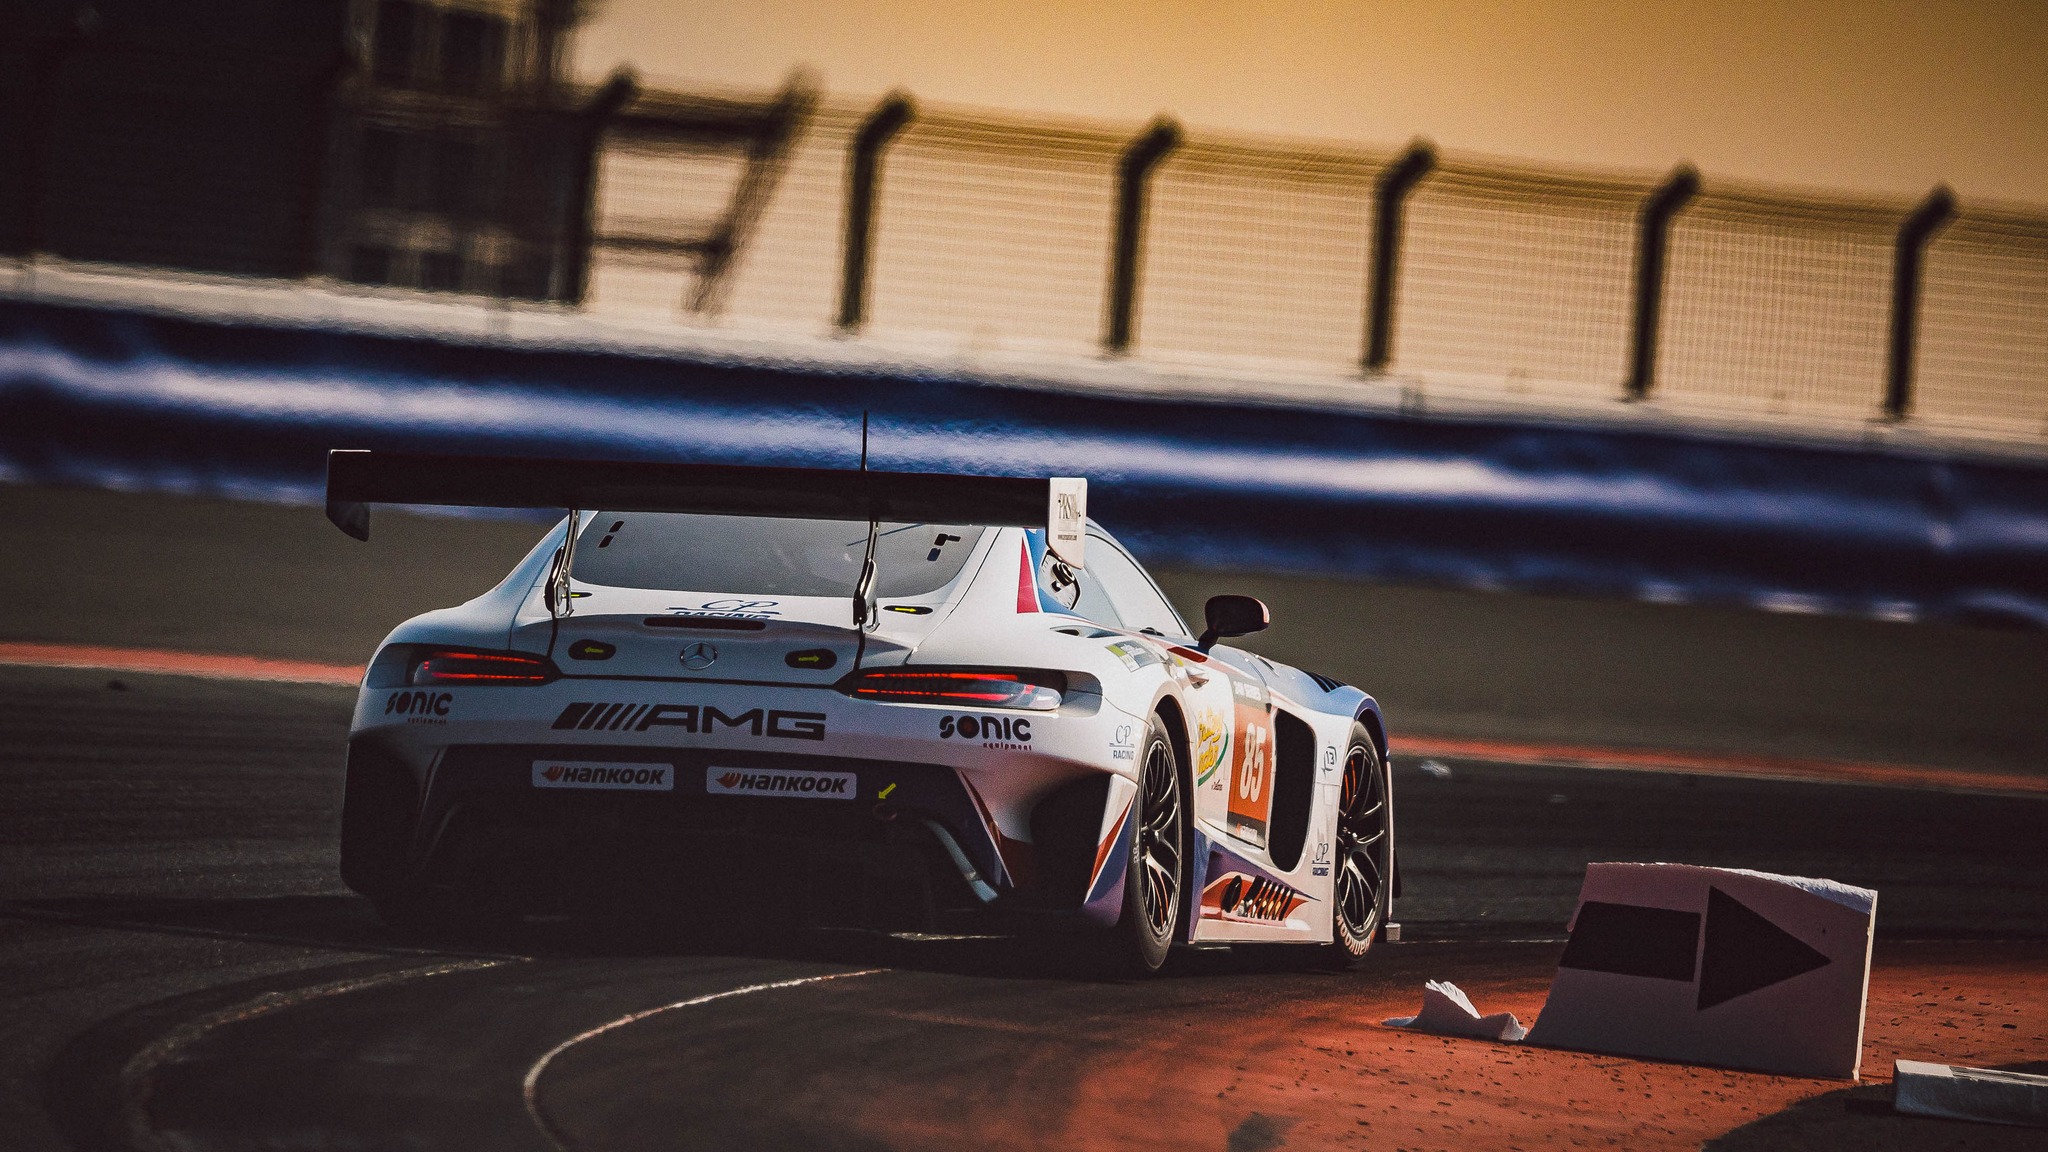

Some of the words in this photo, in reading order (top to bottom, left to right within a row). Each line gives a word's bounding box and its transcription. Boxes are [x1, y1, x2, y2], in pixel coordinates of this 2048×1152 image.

[701, 600, 779, 612] CP
[384, 692, 453, 716] SONIC
[635, 704, 827, 741] AMG
[939, 715, 1032, 742] SONIC
[1116, 724, 1132, 745] CP
[982, 742, 1033, 751] equipment
[1240, 722, 1267, 803] 85
